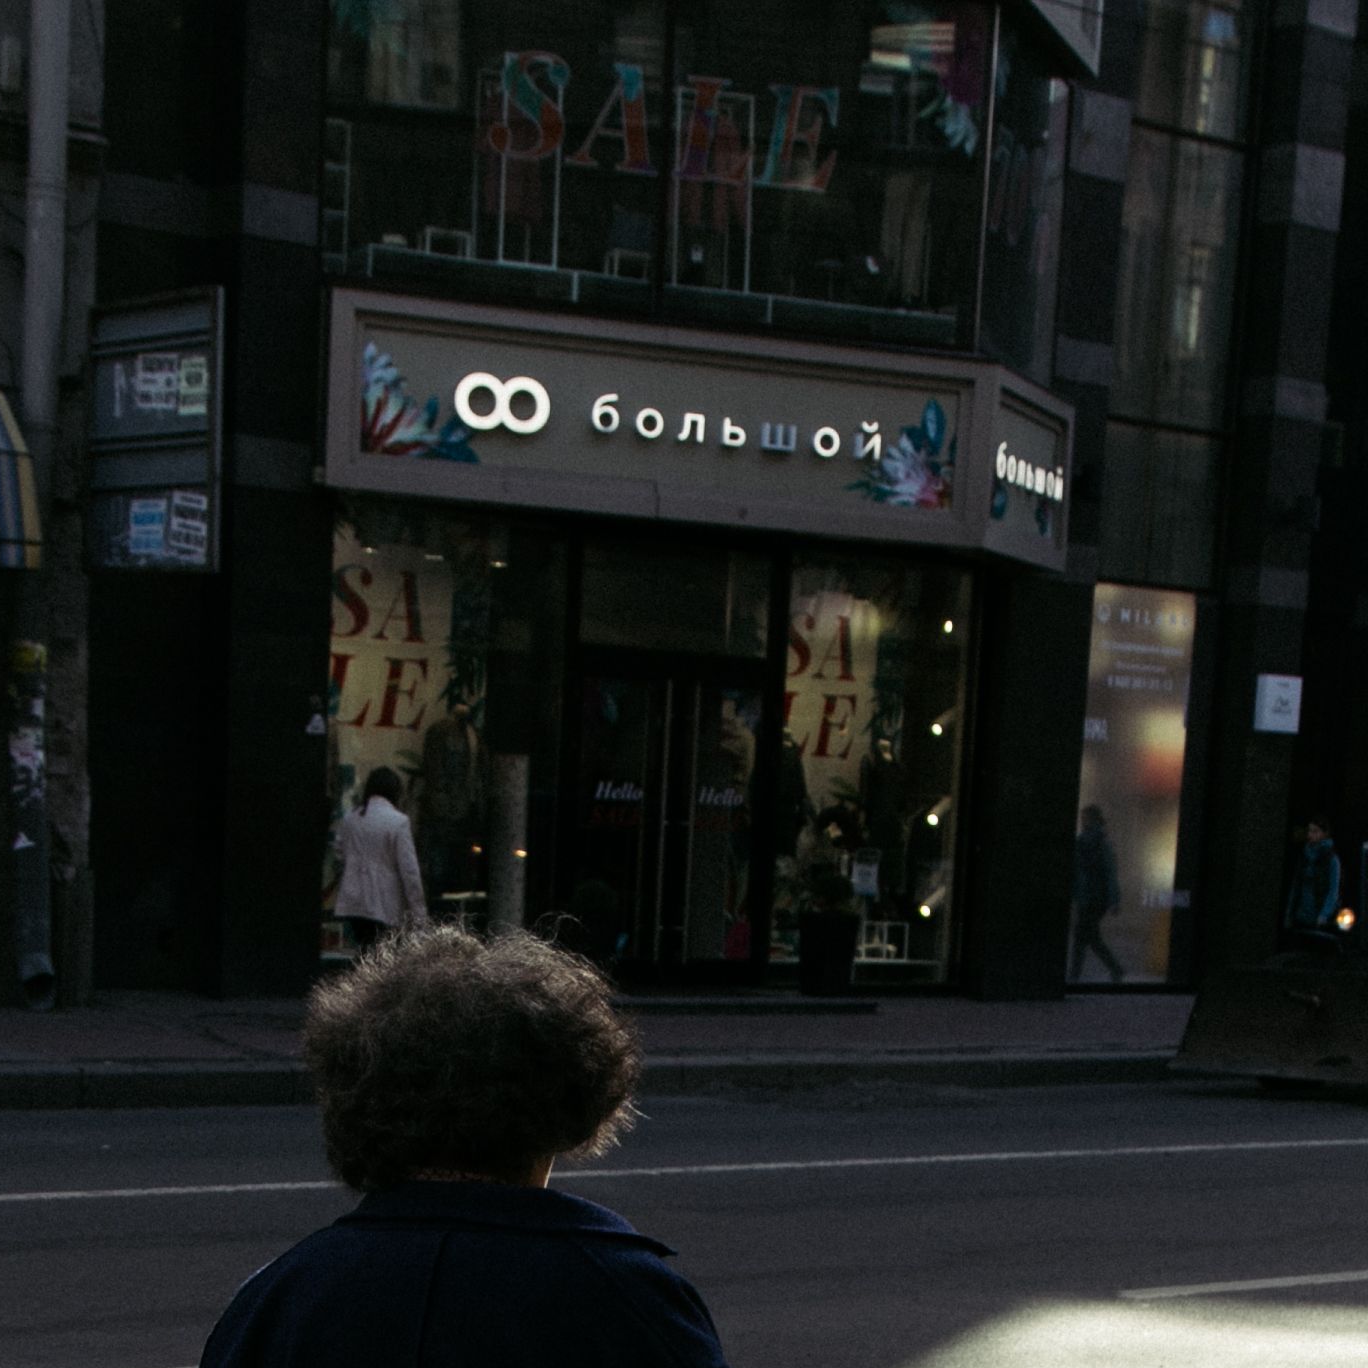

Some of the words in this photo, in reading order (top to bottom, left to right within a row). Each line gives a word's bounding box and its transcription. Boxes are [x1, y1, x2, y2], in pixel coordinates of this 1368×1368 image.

[487, 50, 840, 193] SALE
[591, 391, 882, 461] большой
[996, 440, 1064, 502] большой
[593, 779, 645, 801] Hello
[698, 785, 745, 807] Hello
